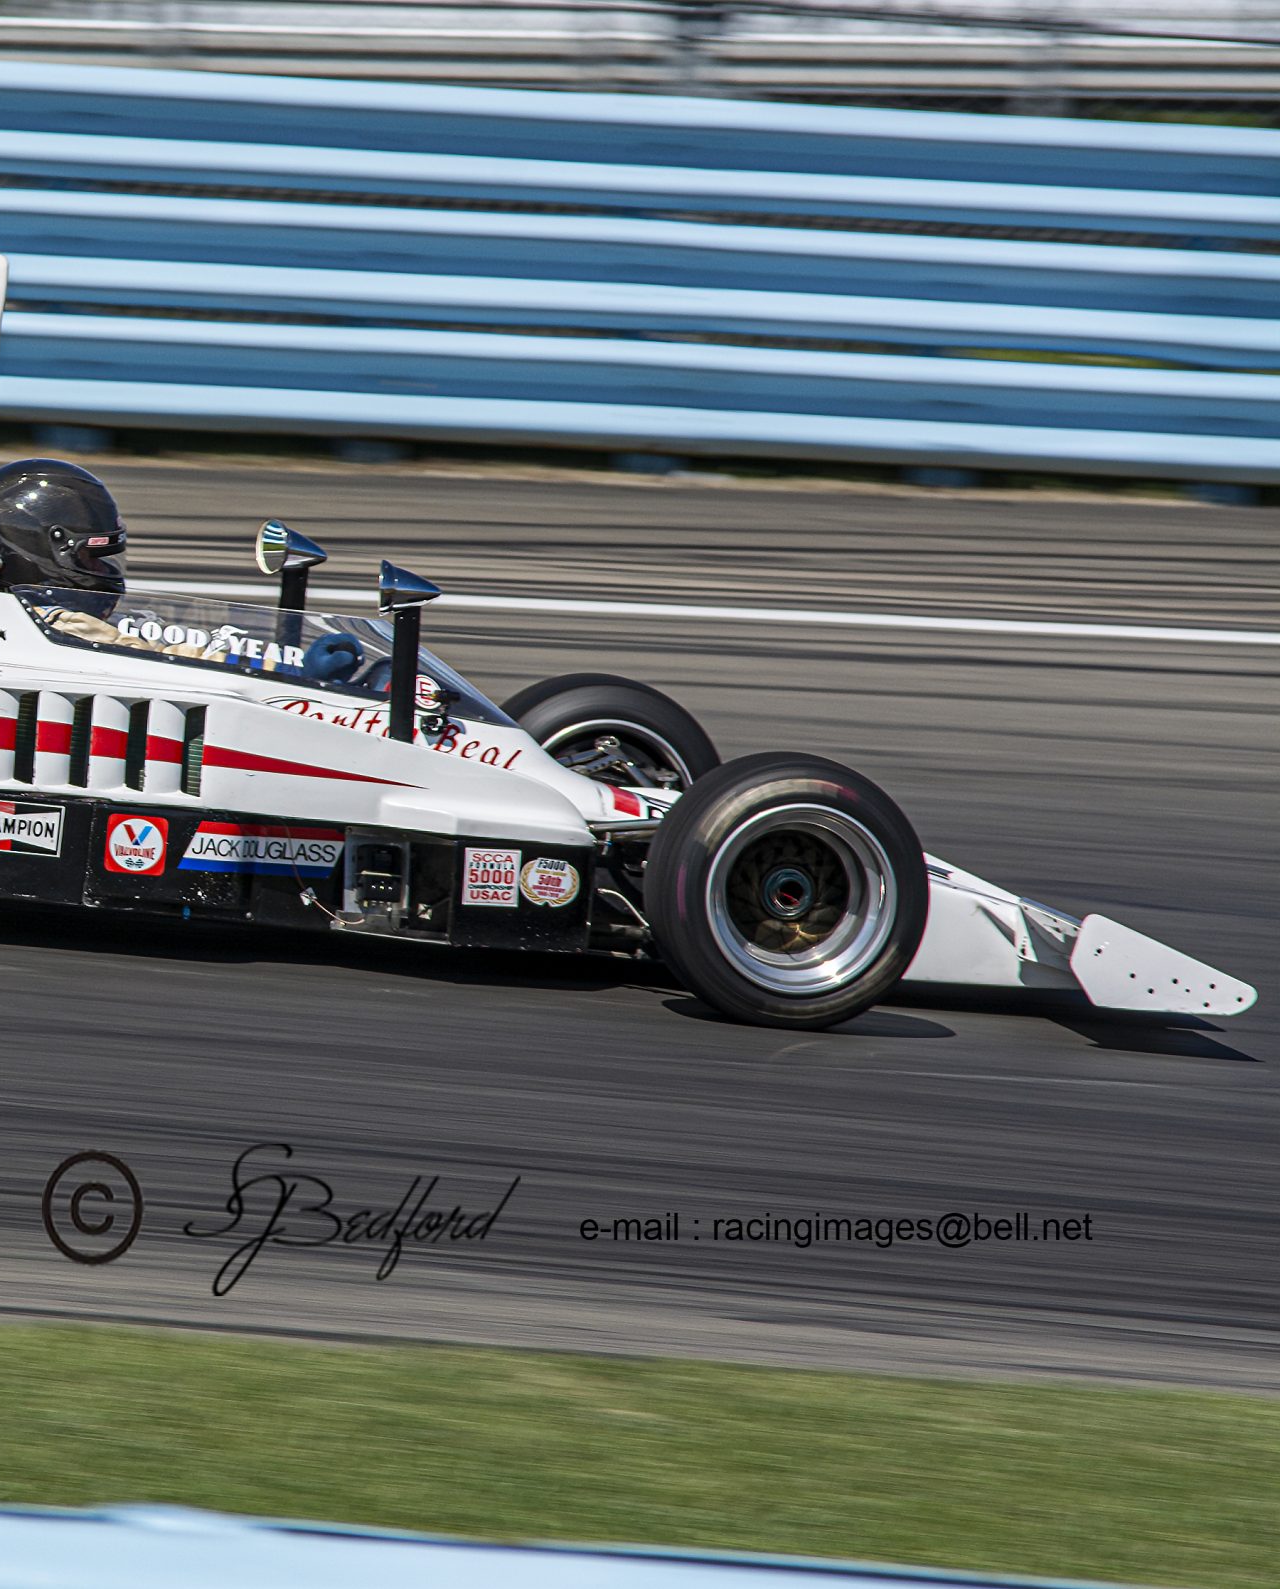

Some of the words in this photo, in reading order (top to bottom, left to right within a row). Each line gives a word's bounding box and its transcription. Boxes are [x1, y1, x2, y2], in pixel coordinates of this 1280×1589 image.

[118, 617, 208, 648] GOOD
[228, 635, 305, 668] YEAR
[434, 724, 522, 771] Beal
[191, 837, 240, 858] JACK
[472, 853, 513, 862] SCCA
[469, 869, 514, 884] 5000
[470, 890, 512, 901] USAC
